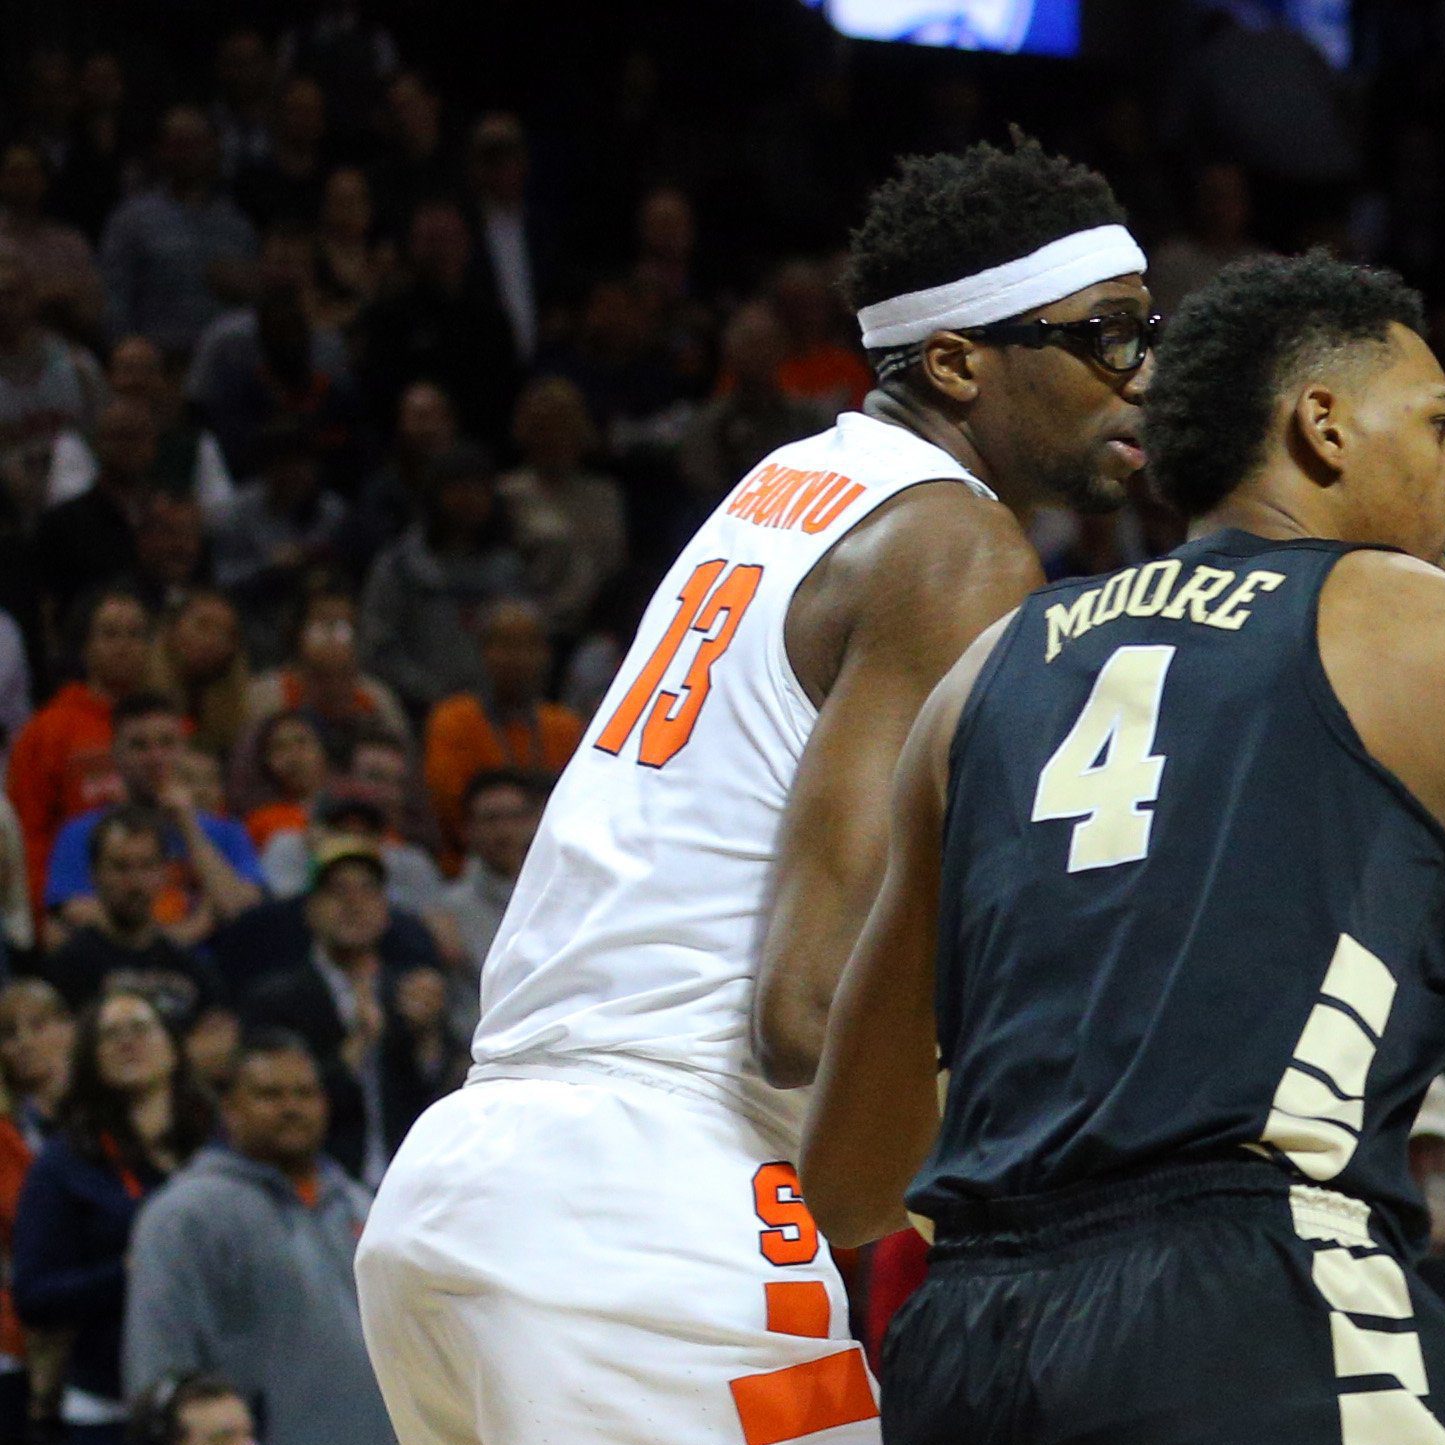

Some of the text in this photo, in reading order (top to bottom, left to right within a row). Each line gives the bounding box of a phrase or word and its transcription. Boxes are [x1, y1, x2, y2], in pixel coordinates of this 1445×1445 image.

[592, 557, 765, 770] 13
[1044, 558, 1287, 664] MOORE
[1030, 644, 1177, 874] 4
[751, 1160, 821, 1267] S
